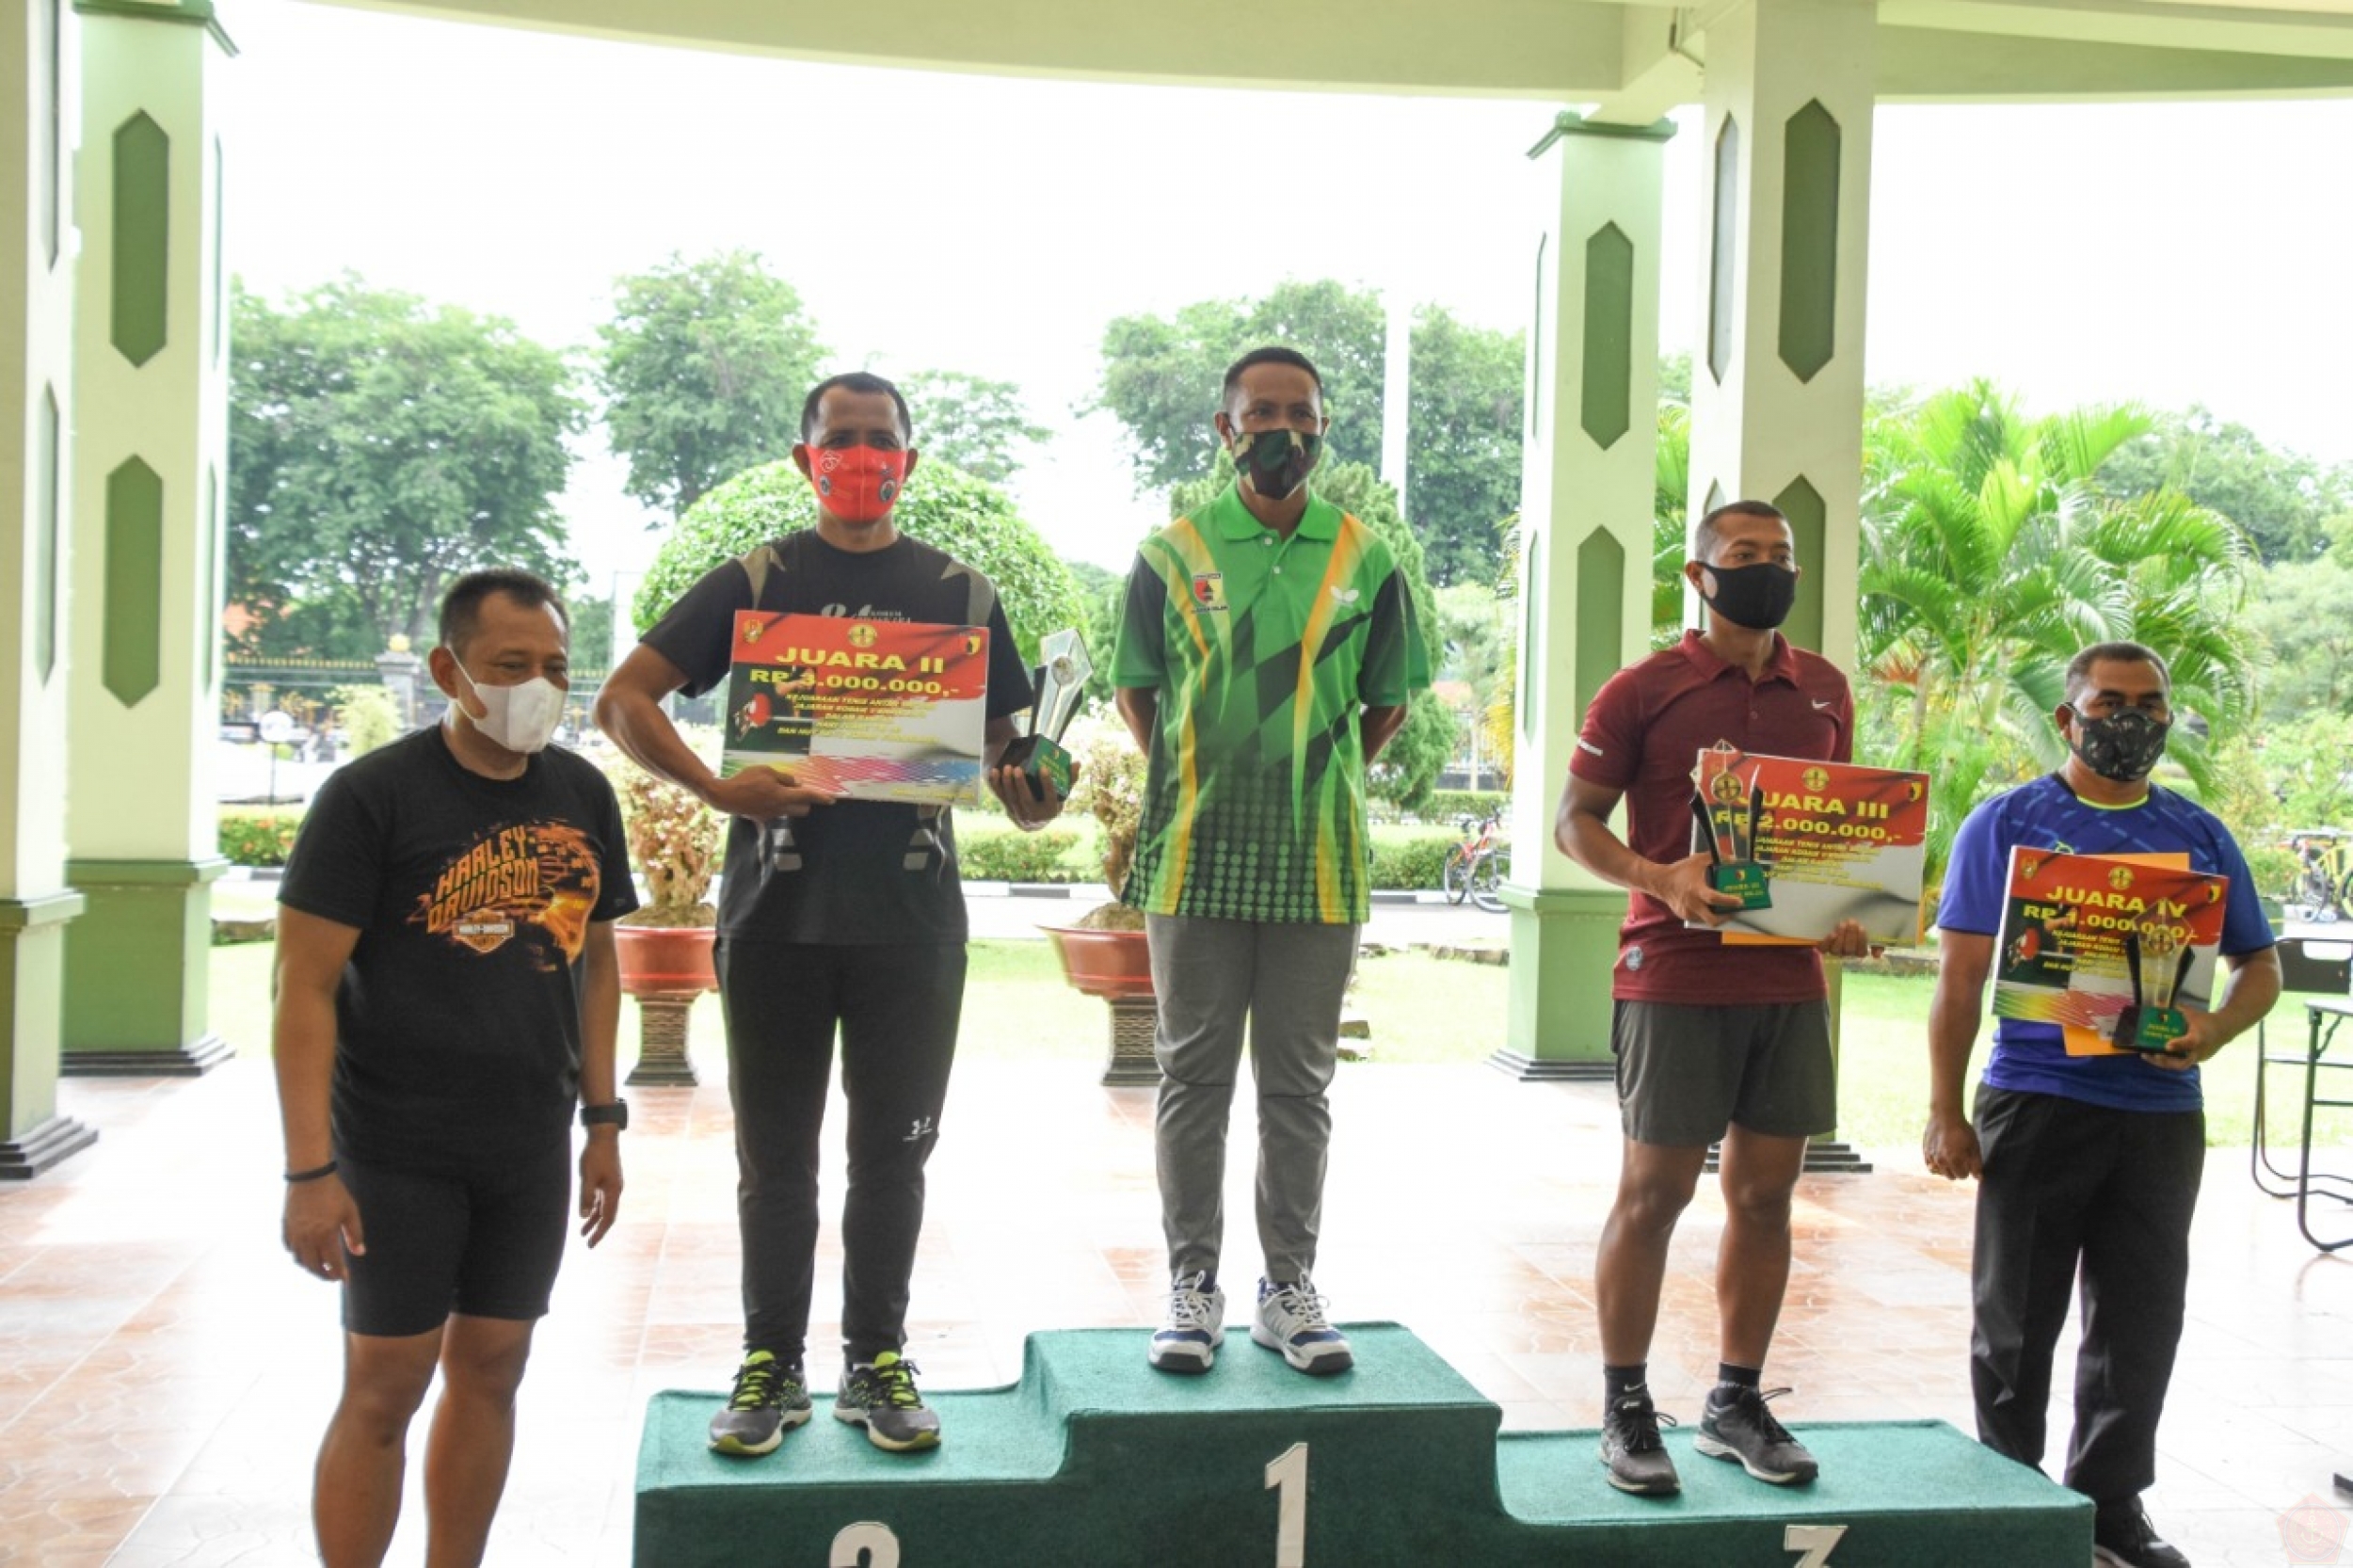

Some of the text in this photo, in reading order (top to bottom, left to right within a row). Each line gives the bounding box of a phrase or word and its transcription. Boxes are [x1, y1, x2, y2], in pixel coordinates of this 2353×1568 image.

[775, 647, 944, 674] JUARA II
[750, 669, 790, 683] RP
[1856, 801, 1889, 820] III
[436, 825, 527, 902] HARLEY
[426, 857, 539, 933] DAVIDSON
[2046, 886, 2188, 919] JUARA IV
[2023, 904, 2057, 920] RP
[1264, 1441, 1309, 1568] 1
